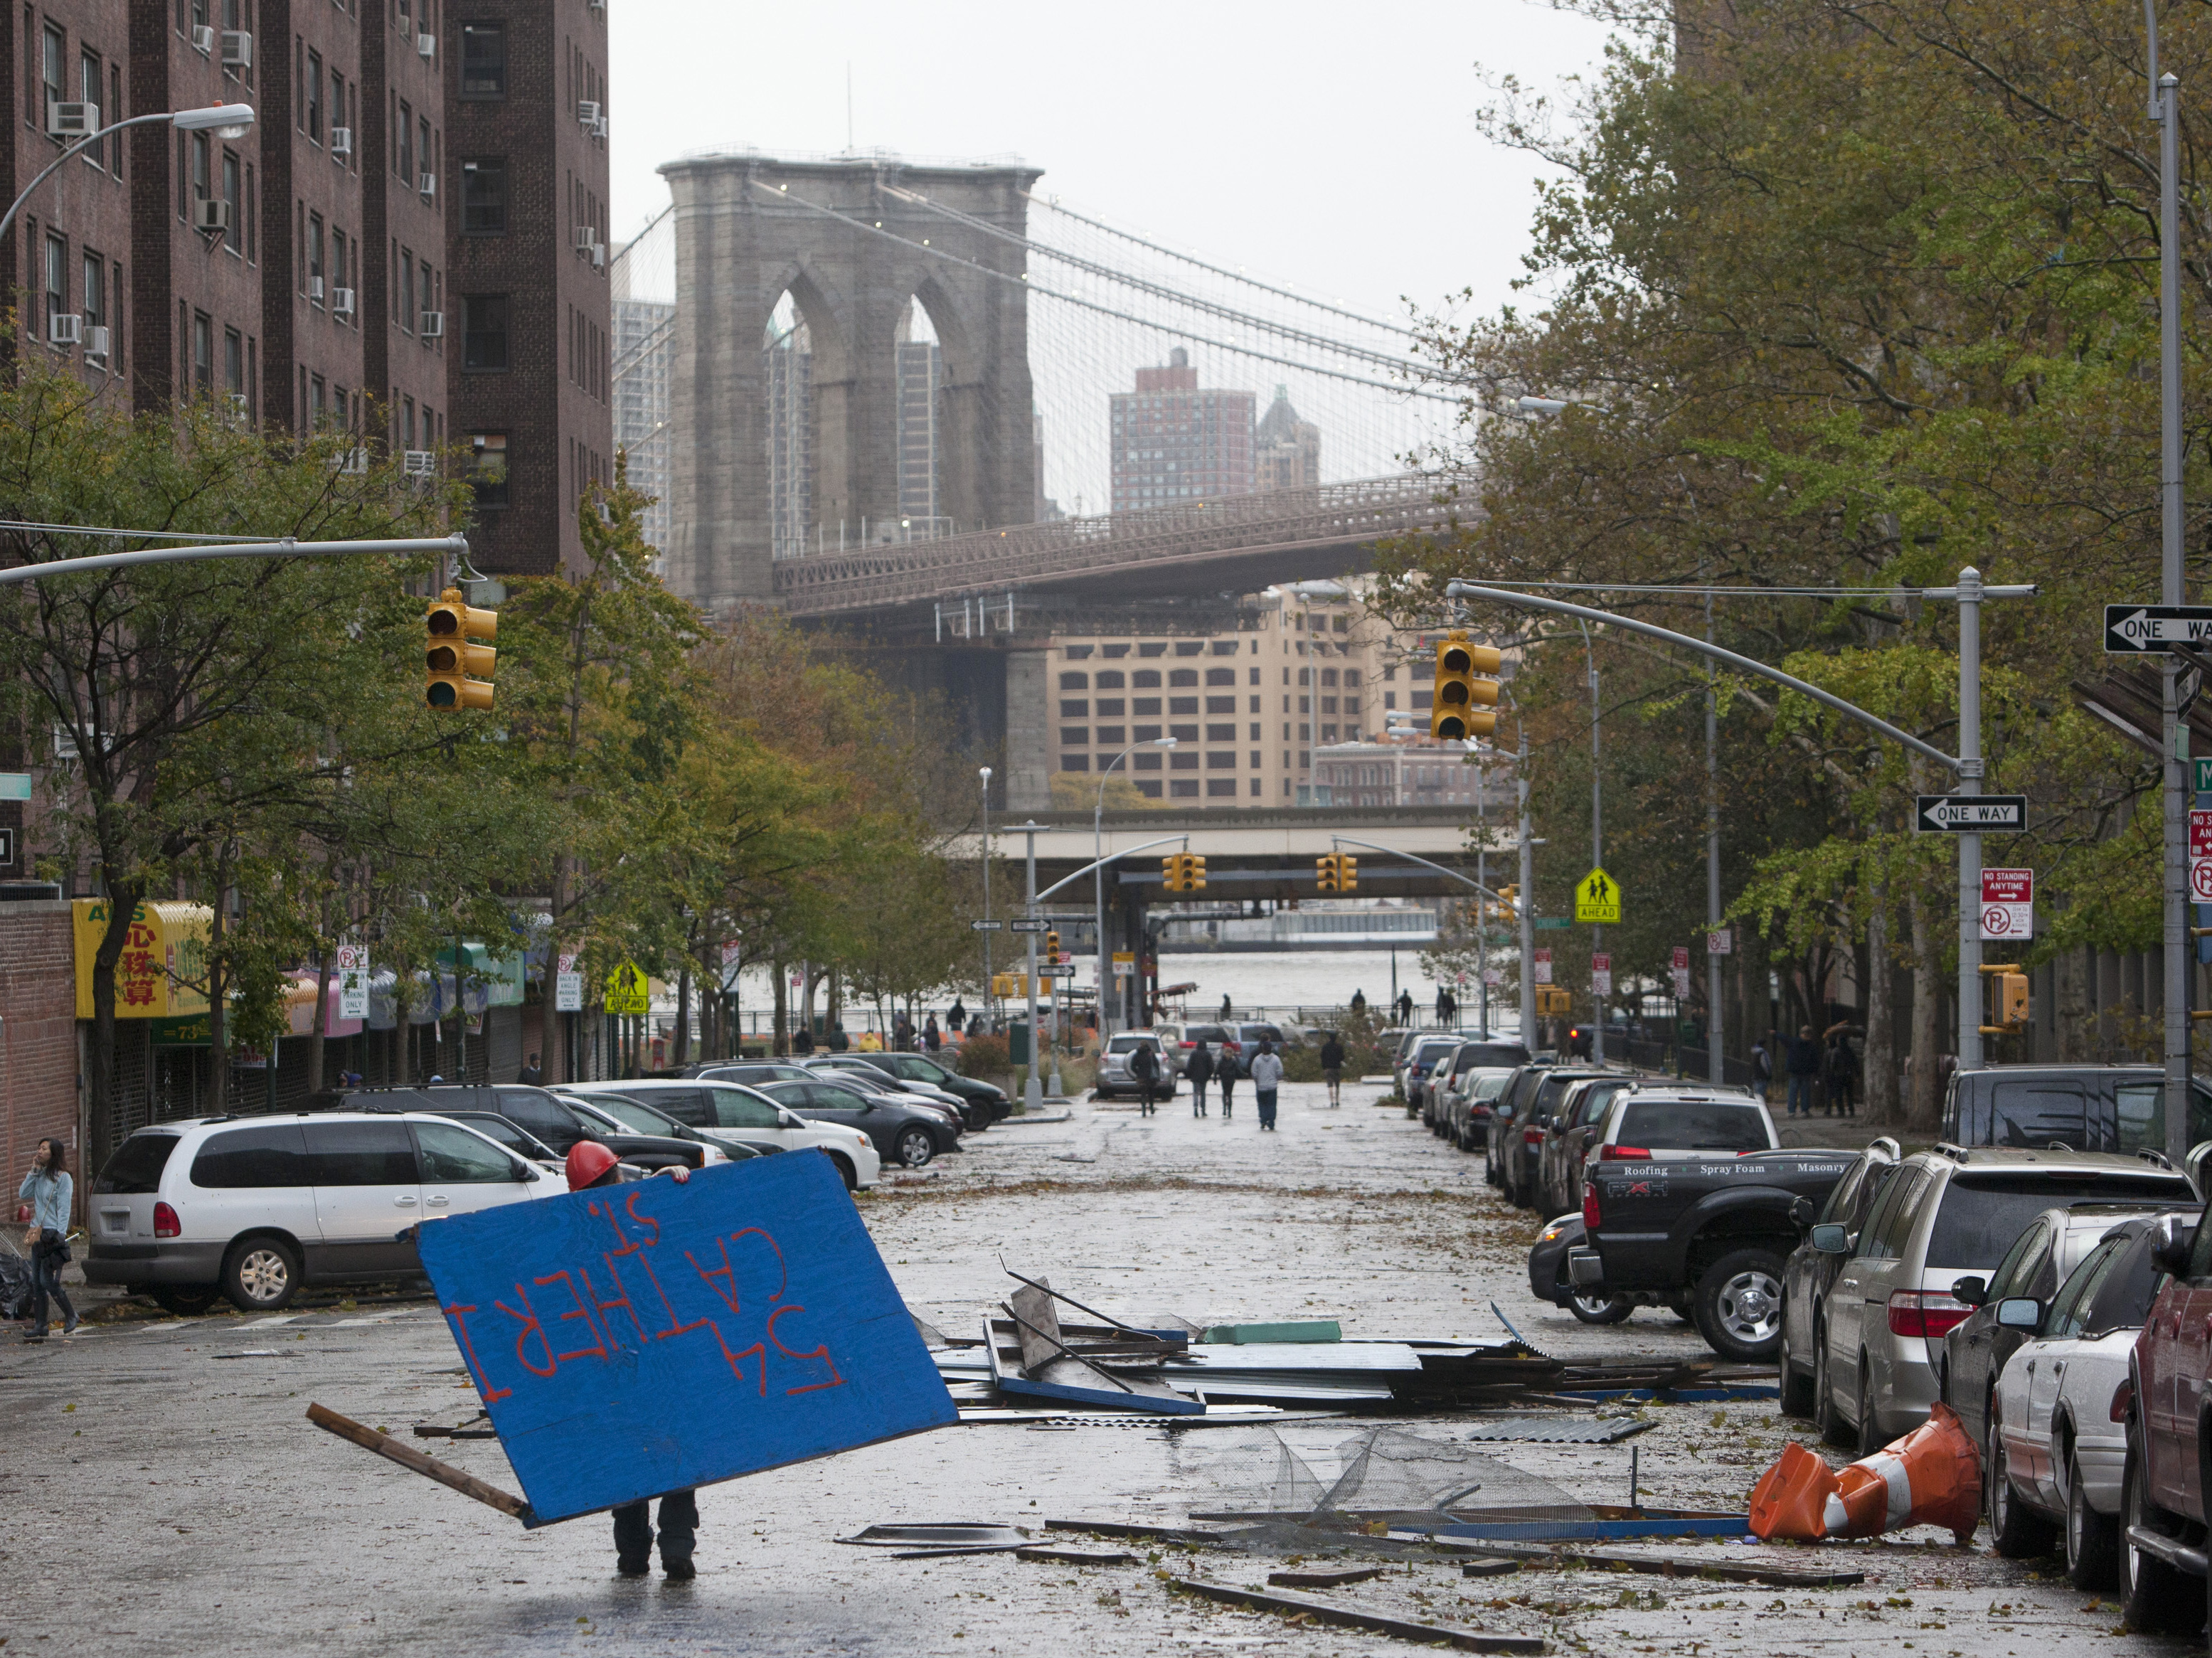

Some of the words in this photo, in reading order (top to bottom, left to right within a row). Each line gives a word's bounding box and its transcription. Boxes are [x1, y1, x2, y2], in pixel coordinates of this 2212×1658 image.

[2125, 620, 2162, 638] ONE
[2188, 622, 2212, 639] WA
[1938, 807, 1969, 820] ONE
[1978, 807, 2010, 820] WAY
[2193, 815, 2203, 825] NO
[1996, 872, 2029, 881] STANDING
[1581, 908, 1615, 917] AHEAD
[1624, 1167, 1668, 1176] Roofing
[1700, 1164, 1731, 1174] Spray
[1735, 1164, 1765, 1173] Foam
[1797, 1163, 1846, 1174] Masonry
[711, 1304, 848, 1398] 54
